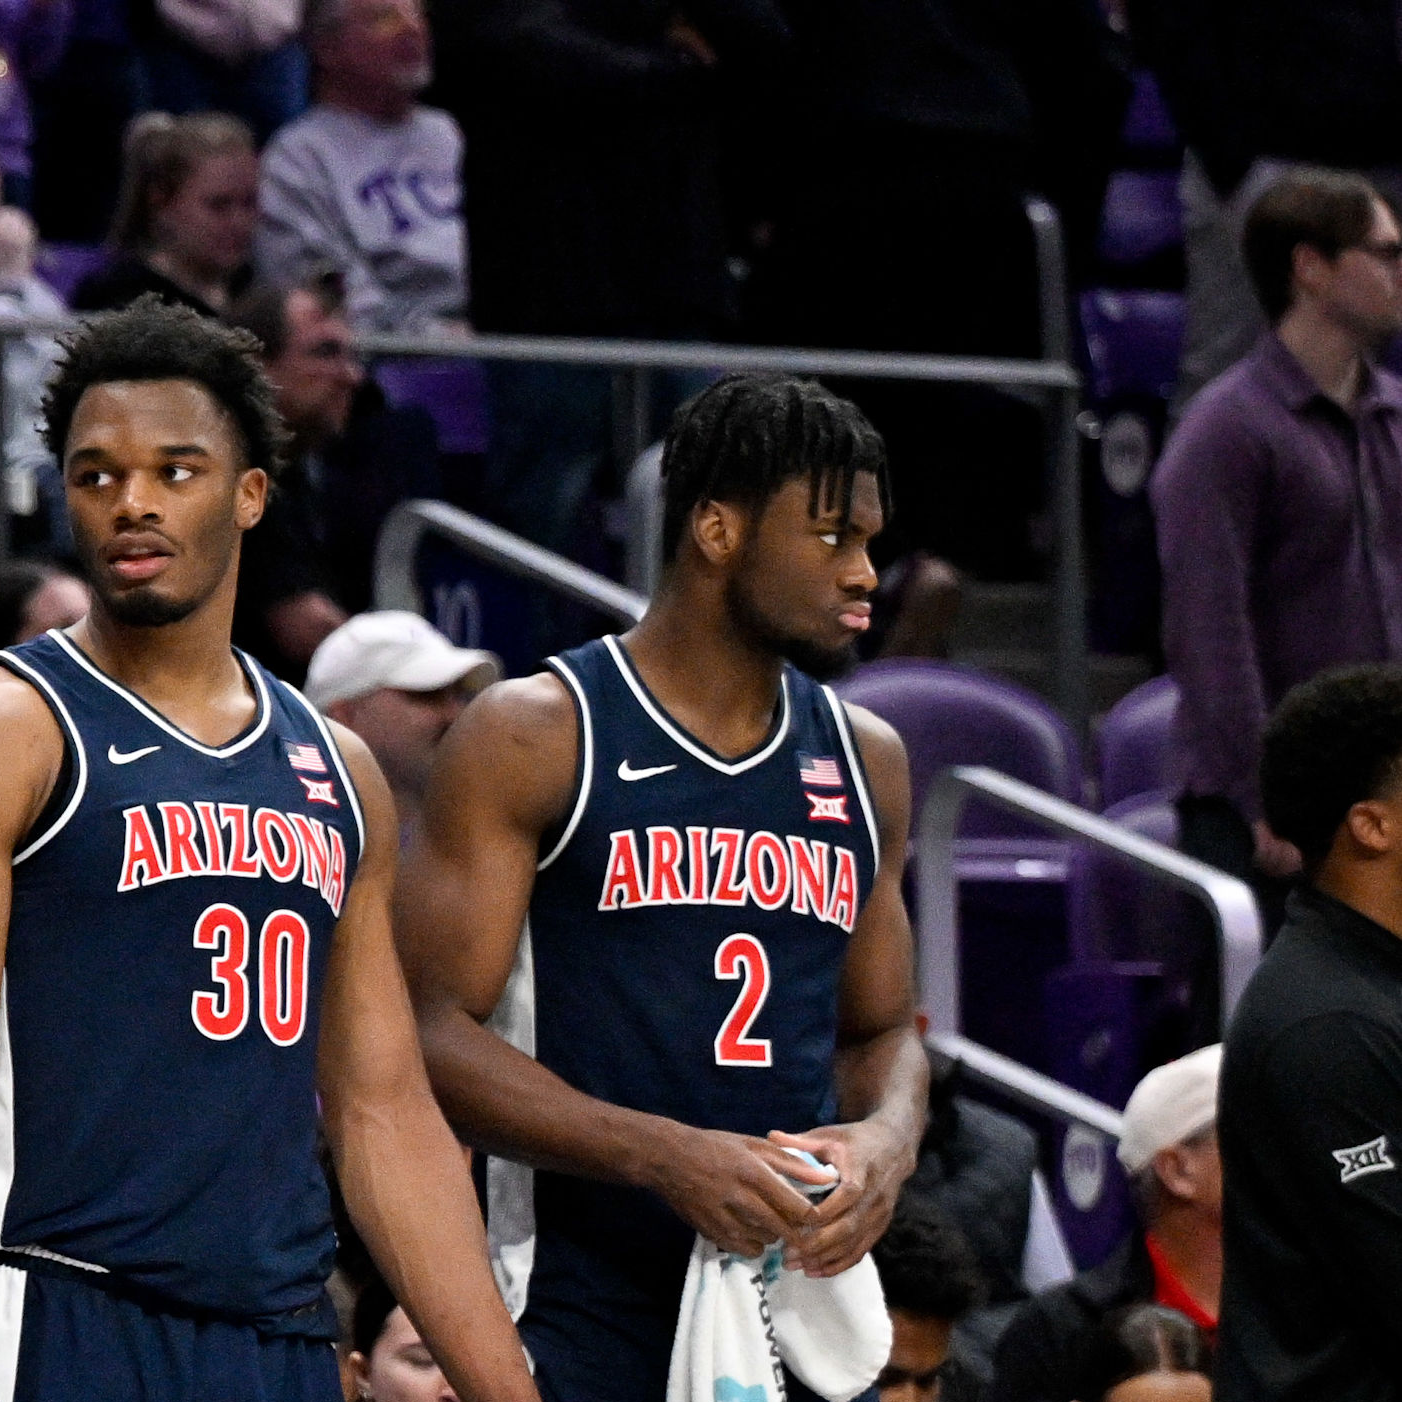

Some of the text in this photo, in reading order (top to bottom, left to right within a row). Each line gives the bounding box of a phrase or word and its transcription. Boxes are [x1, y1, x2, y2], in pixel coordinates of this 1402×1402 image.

[117, 801, 346, 918] ARIZONA
[598, 826, 858, 934] ARIZONA
[191, 903, 310, 1046] 30
[714, 932, 772, 1067] 2
